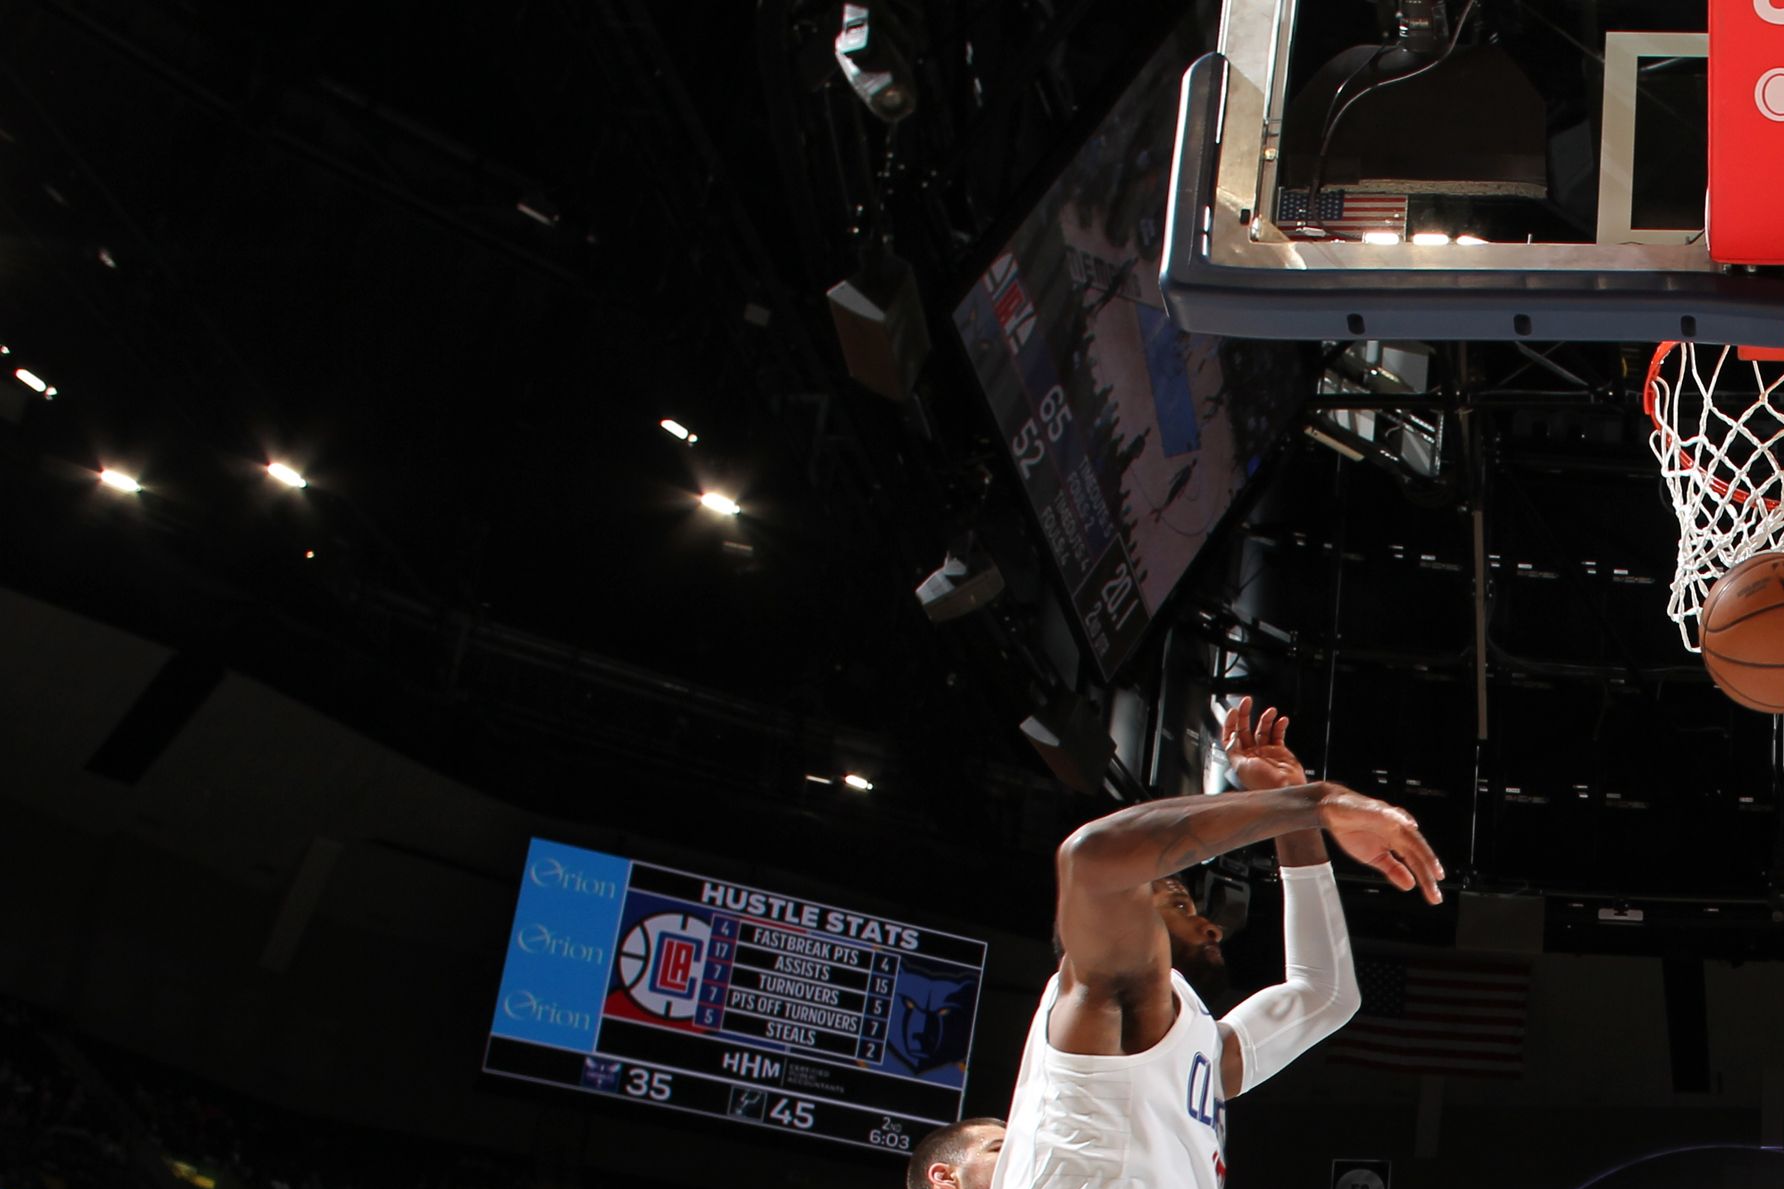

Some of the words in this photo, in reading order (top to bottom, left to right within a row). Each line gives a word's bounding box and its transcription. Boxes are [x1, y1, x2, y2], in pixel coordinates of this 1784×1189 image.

[1039, 384, 1073, 442] 65
[1012, 418, 1045, 480] 52
[530, 857, 617, 900] Orion
[701, 882, 819, 928] HUSTLE
[825, 911, 920, 950] STATS
[720, 920, 730, 936] 4
[517, 923, 604, 965] Orion
[714, 942, 728, 958] 17
[753, 928, 833, 959] FASTBREAK
[834, 944, 860, 967] PTS
[712, 964, 723, 979] 7
[774, 955, 831, 981] ASSISTS
[879, 956, 890, 972] 4
[708, 986, 719, 1002] 7
[758, 973, 840, 1006] TURNOVERS
[874, 977, 889, 994] 15
[503, 990, 591, 1032] Orion
[703, 1009, 714, 1025] 5
[730, 990, 755, 1011] PTS
[756, 995, 782, 1017] OFF
[783, 1000, 859, 1033] TURNOVERS
[873, 999, 884, 1015] 5
[765, 1022, 817, 1047] STEALS
[869, 1021, 880, 1036] 7
[865, 1042, 876, 1059] 2
[721, 1050, 781, 1079] HHM
[624, 1068, 673, 1101] 35
[769, 1098, 816, 1130] 45
[882, 1116, 903, 1133] 2ND
[869, 1128, 911, 1150] 6:03
